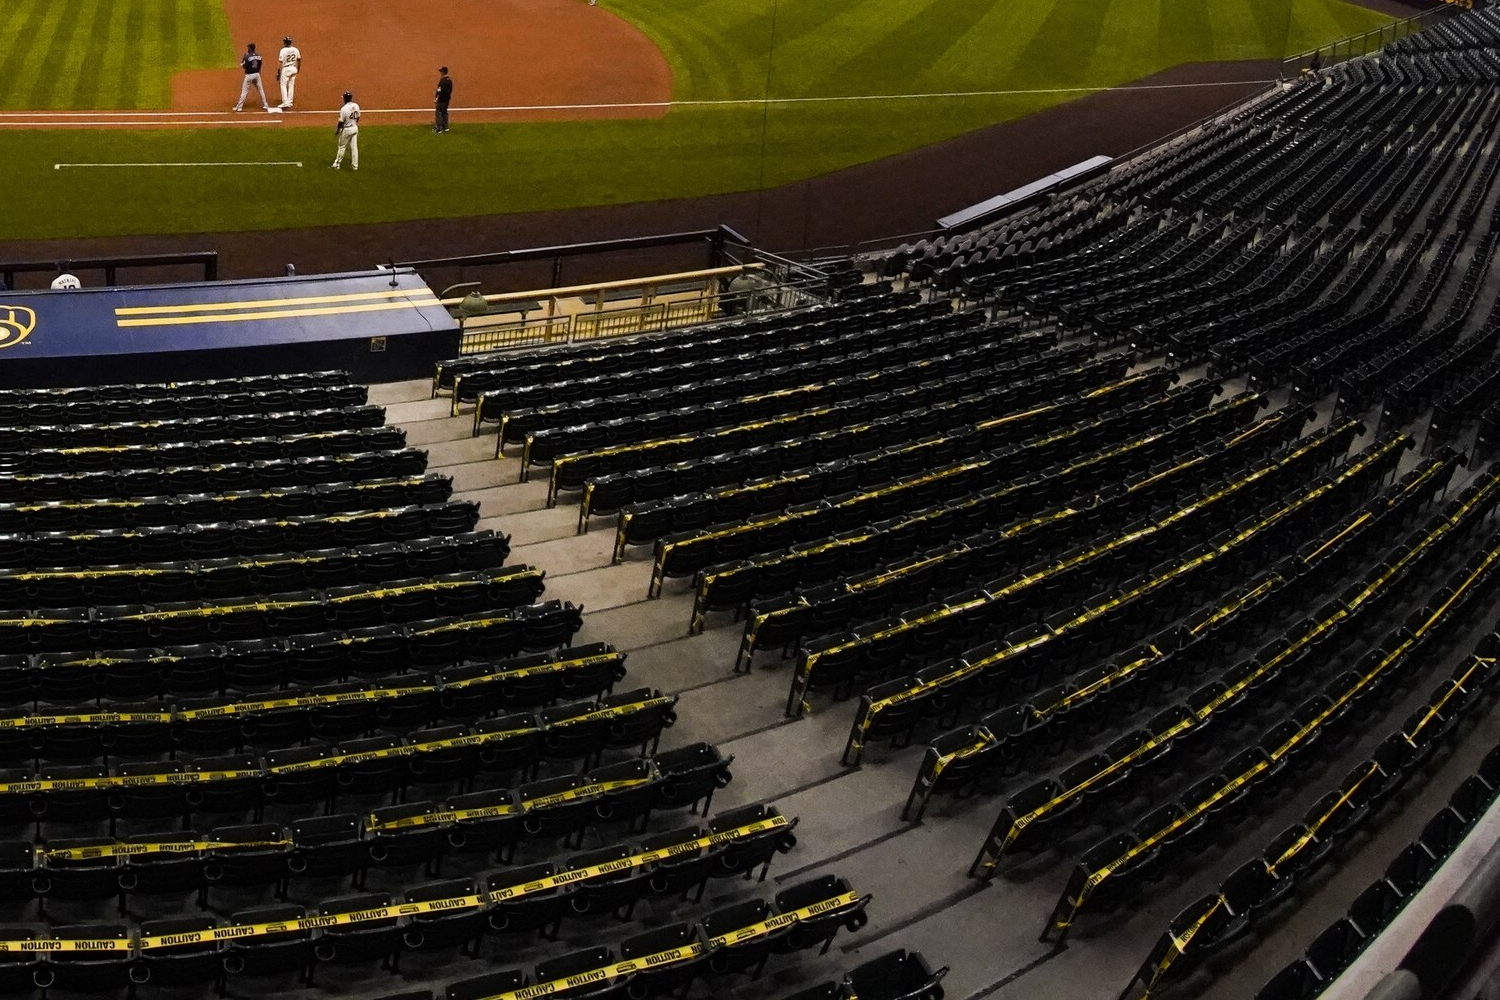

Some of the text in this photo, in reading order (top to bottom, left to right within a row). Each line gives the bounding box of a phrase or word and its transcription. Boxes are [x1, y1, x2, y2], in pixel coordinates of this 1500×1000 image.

[286, 54, 296, 62] 22
[552, 870, 589, 885] CAUTION
[429, 898, 466, 911] CAUTION
[350, 908, 388, 923] CAUTION
[160, 932, 201, 946] CAUTION
[214, 926, 254, 940] CAUTION
[21, 940, 62, 951] CAUTION
[75, 939, 116, 950] CAUTION
[645, 950, 681, 967] CAUTION
[566, 969, 607, 988] CAUTION
